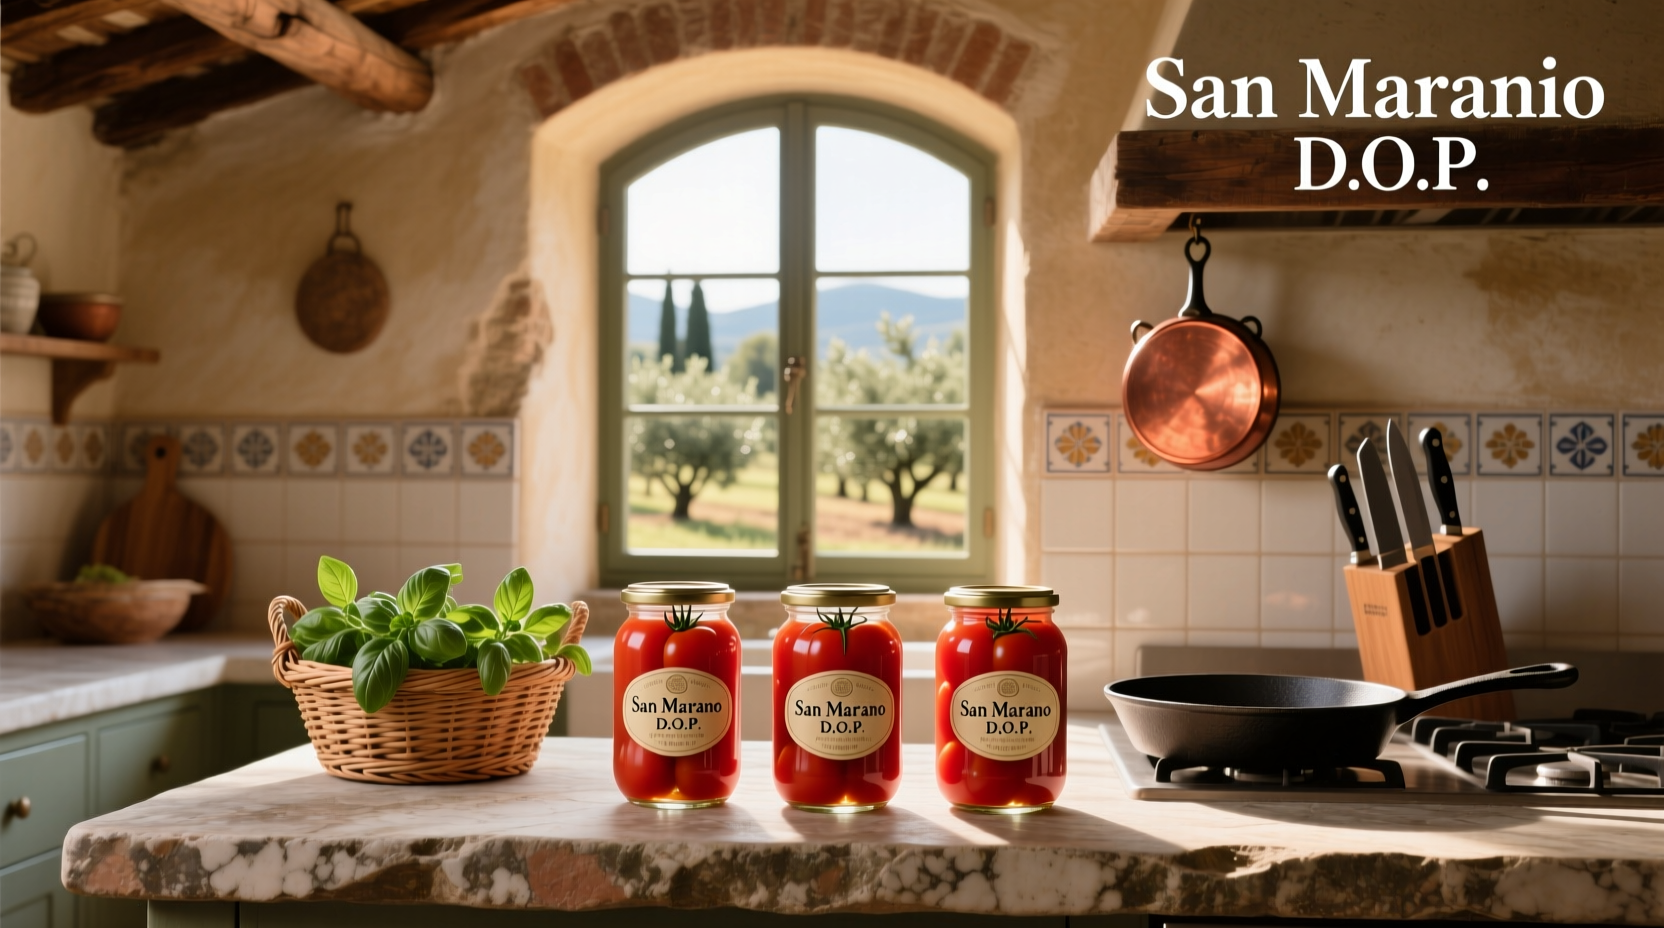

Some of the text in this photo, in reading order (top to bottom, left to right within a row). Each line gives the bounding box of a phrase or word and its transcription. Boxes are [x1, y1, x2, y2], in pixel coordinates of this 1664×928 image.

[631, 695, 722, 714] San Marano
[795, 699, 886, 717] San Marano
[960, 699, 1051, 718] San Marano
[656, 717, 701, 730] D.O.P.
[820, 720, 865, 734] D.O.P.
[986, 721, 1032, 735] D.O.P.
